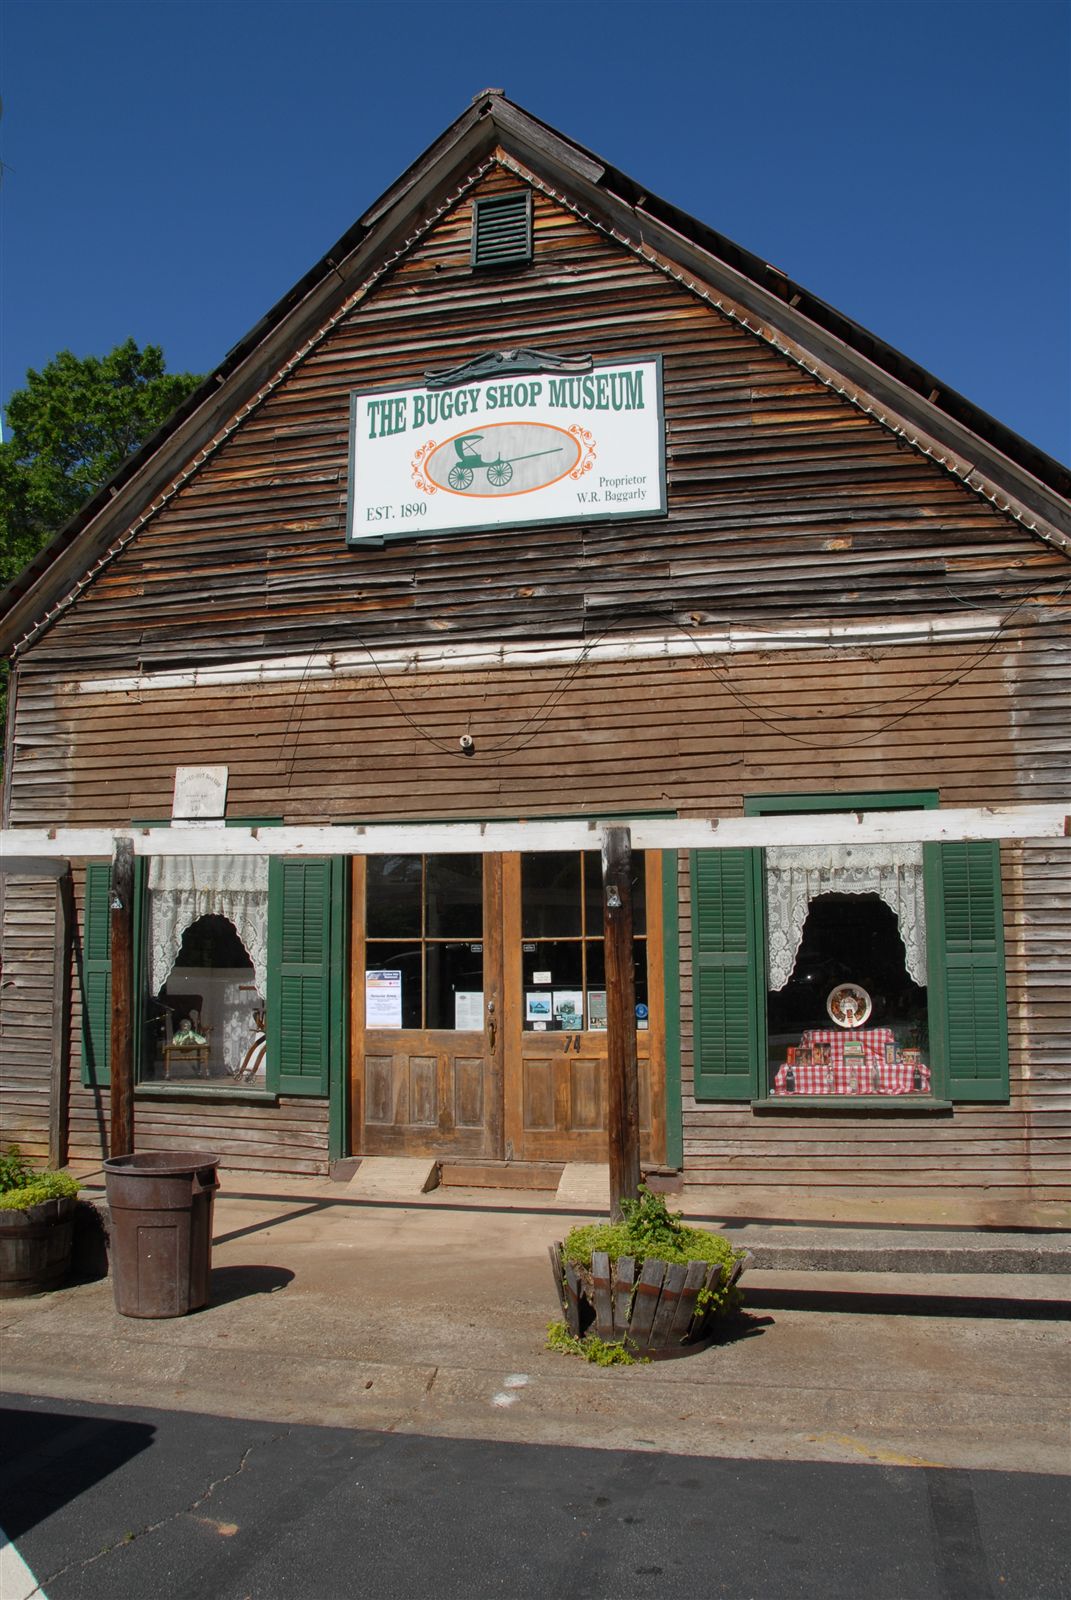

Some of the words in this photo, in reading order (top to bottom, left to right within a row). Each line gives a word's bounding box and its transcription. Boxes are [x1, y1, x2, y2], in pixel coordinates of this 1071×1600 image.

[367, 397, 407, 439] THE
[412, 388, 481, 429] BUGGY
[486, 381, 542, 410] SHOP
[548, 370, 645, 411] MUSEUM
[599, 475, 647, 488] Proprietor
[576, 492, 601, 503] W.R.
[604, 488, 647, 503] Baggarly
[366, 506, 396, 521] EST.
[400, 502, 427, 518] 1890
[564, 1035, 581, 1053] 74
